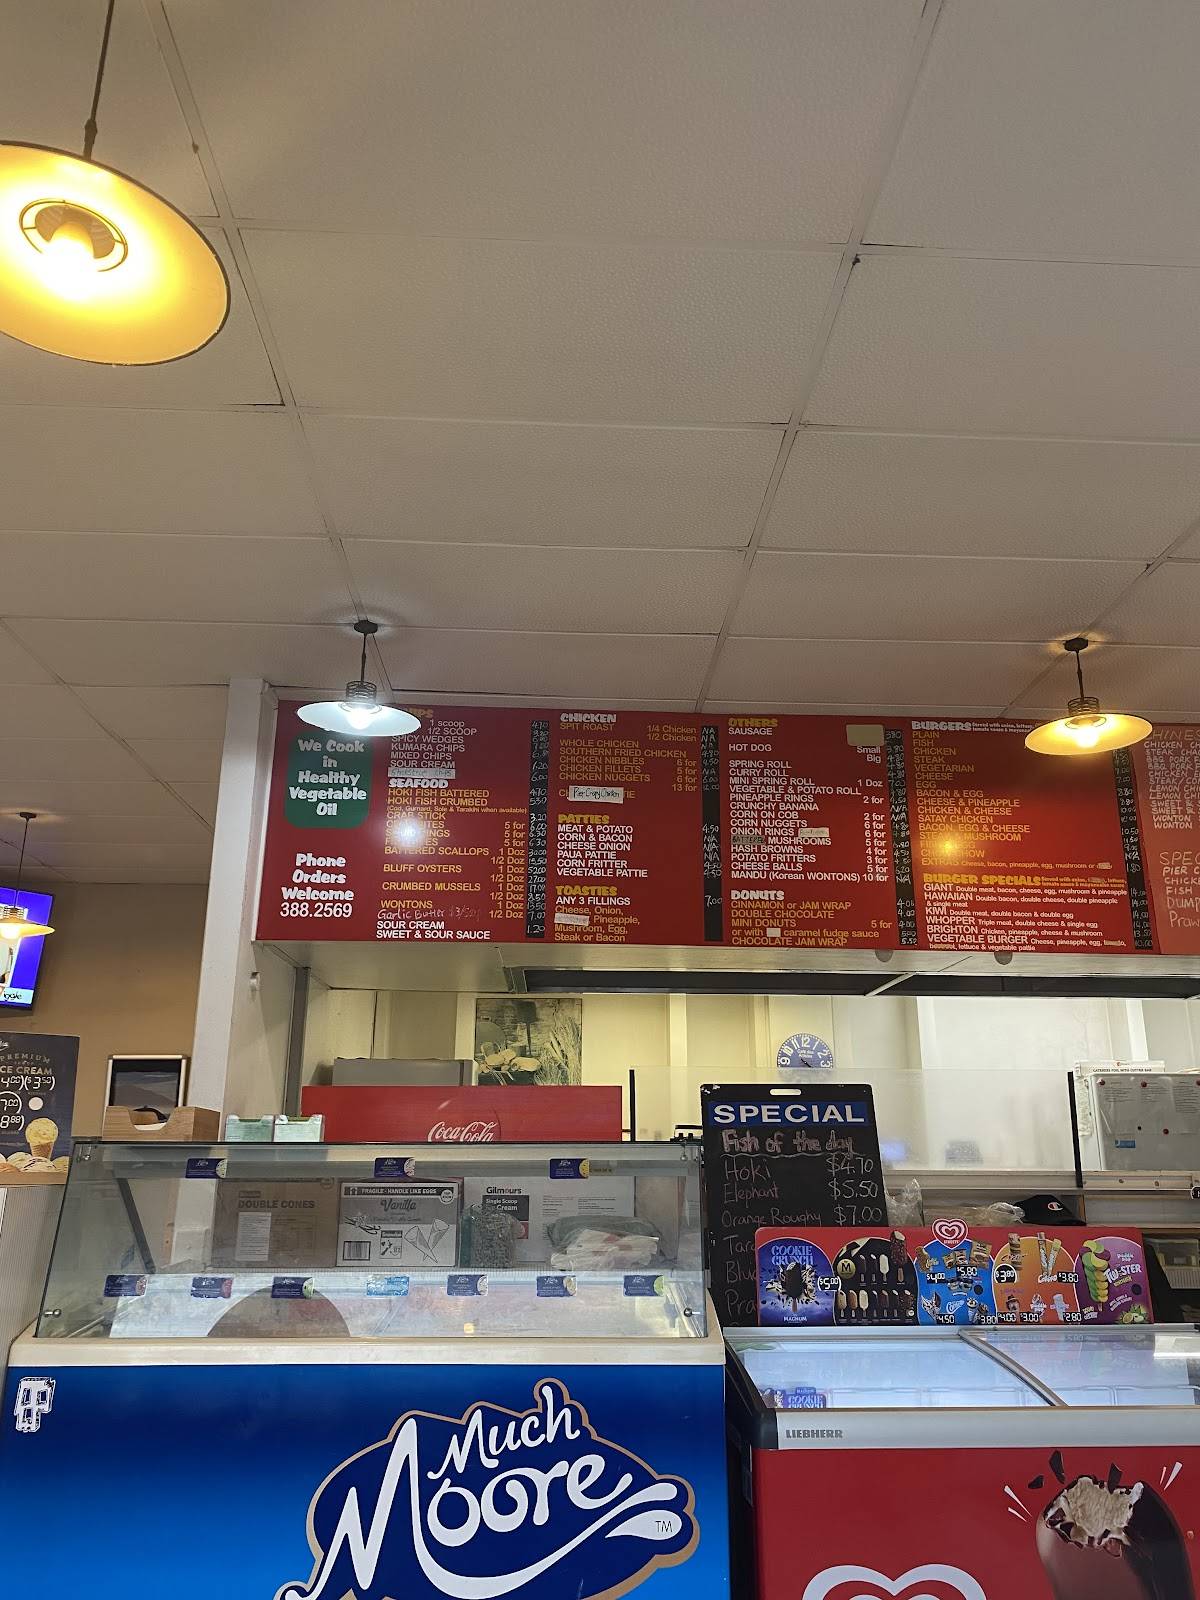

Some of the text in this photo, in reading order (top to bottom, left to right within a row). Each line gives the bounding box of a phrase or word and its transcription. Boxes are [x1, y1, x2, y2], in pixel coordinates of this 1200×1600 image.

[560, 713, 617, 723] CHICKEN
[728, 718, 778, 727] OTHERS
[912, 720, 972, 730] BURGERS
[298, 739, 365, 752] We Cook
[392, 743, 465, 752] KUMARA CHIPS
[423, 752, 452, 760] CHIPS
[644, 750, 686, 758] CHICKEN
[560, 756, 644, 765] CHICKEN NIBBLES
[729, 760, 764, 768] SPRING
[605, 765, 641, 773] FILLETS
[915, 764, 974, 772] VEGETARIAN
[298, 771, 360, 785] Healthy
[752, 777, 787, 785] SPRING
[389, 778, 448, 788] SEAFOOD
[289, 786, 367, 802] Vegetable
[388, 788, 412, 796] HOKI
[440, 798, 487, 806] CRUMBED
[730, 794, 813, 802] PINEAPPLE RINGS
[316, 803, 337, 815] Oil
[730, 802, 775, 810] CRUNCHY
[558, 814, 609, 824] PATTIES
[731, 819, 807, 828] CORN NUGGETS
[950, 815, 993, 823] CHICKEN
[768, 837, 831, 845] MUSHROOMS
[585, 851, 616, 859] PATTIE
[731, 854, 768, 862] POTATO
[296, 853, 346, 867] Phone
[557, 859, 627, 868] CORN FRITTER
[384, 864, 461, 873] BLUFF OYSTERS
[731, 862, 802, 871] CHEESE BALLS
[292, 869, 346, 884] Orders
[557, 868, 648, 877] VEGETABLE PATTIE
[731, 871, 860, 882] MANDU (Korean WONTONS)
[1163, 867, 1188, 877] PIER
[923, 873, 1041, 885] BURGER SPECIALS
[281, 887, 354, 900] Welcome
[556, 886, 617, 896] TOASTIES
[731, 890, 784, 900] DONUTS
[1166, 887, 1192, 895] FISH
[924, 892, 973, 900] HAWAIIAN
[280, 902, 352, 918] 388.2569
[377, 909, 444, 920] Garlic Butter
[732, 910, 834, 918] DOUBLE CHOCOLATE
[925, 907, 946, 915] KIWI
[732, 919, 752, 927] MINI
[926, 916, 975, 924] WHOPPER
[377, 921, 444, 929] SOUR CREAM
[927, 925, 978, 934] BRIGHTON
[732, 937, 847, 946] CHOCOLATE JAM WRAP
[928, 934, 1027, 944] VEGETABLE BURGER
[16, 1066, 52, 1075] CREAM
[714, 1105, 864, 1123] SPECIAL
[722, 1129, 759, 1153] Fish
[793, 1130, 821, 1151] the
[826, 1130, 853, 1159] day
[724, 1156, 771, 1181] Hoki
[826, 1153, 873, 1176] $4.70
[828, 1179, 878, 1199] $5.50
[724, 1181, 778, 1208] Elephant
[381, 1200, 416, 1211] Vanilla
[722, 1208, 821, 1227] Orange Roughy
[834, 1204, 882, 1225] $7.00
[771, 1246, 812, 1256] COOKIE
[772, 1255, 813, 1265] CRUNCH
[428, 1385, 580, 1480] Much
[786, 1430, 843, 1438] LIEBHERR
